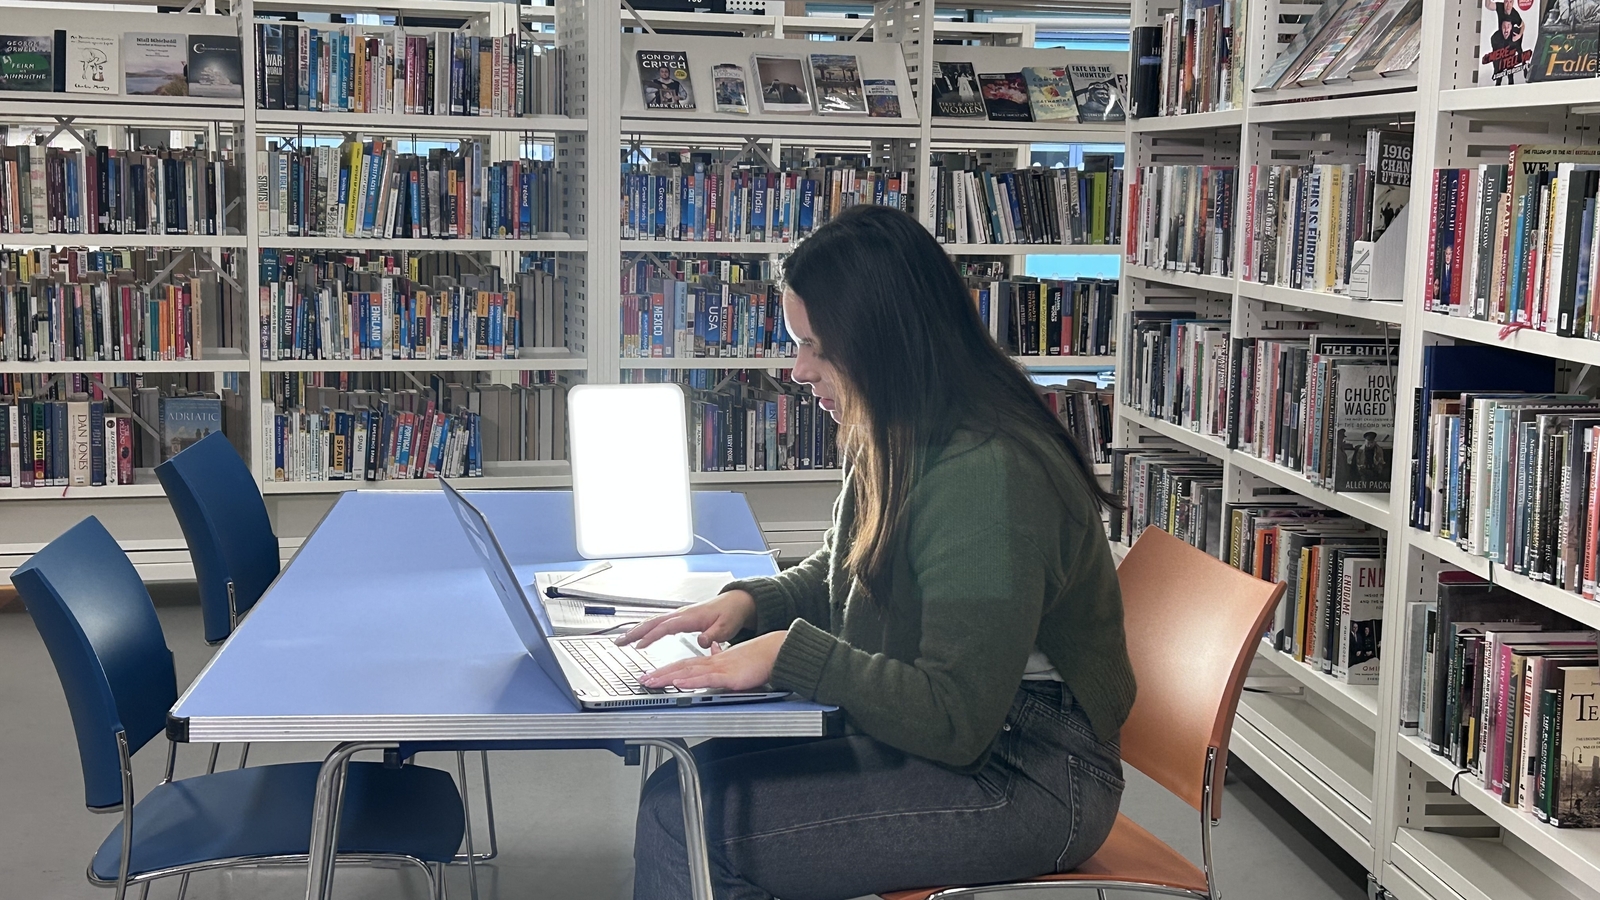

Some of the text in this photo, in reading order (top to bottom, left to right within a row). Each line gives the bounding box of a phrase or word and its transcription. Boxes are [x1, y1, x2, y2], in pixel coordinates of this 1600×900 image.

[266, 54, 282, 66] WAR
[266, 67, 282, 76] WORLD
[642, 61, 686, 69] CRITCH
[940, 106, 983, 114] WOMEN
[1382, 144, 1411, 160] 1916
[1381, 160, 1411, 174] CHAN
[1381, 171, 1410, 186] UTTE
[258, 176, 268, 202] STRAITS
[1267, 170, 1275, 201] AGAINST
[1503, 150, 1516, 238] WE DECLARE
[754, 190, 764, 214] India
[803, 191, 812, 208] Italy
[1439, 174, 1448, 230] MEGHAN
[1448, 180, 1459, 232] Charles III
[1482, 176, 1496, 249] John Bercow
[1264, 218, 1272, 236] ODDS
[1304, 176, 1321, 280] THIS IS EUROPE
[1428, 172, 1440, 286] FINDING FREEDOM
[1522, 186, 1533, 274] BACKWARD GLANCE
[284, 308, 292, 336] IRELAND
[372, 306, 380, 340] ENGLAND
[654, 306, 663, 336] MEXICO
[708, 306, 718, 330] USA
[1324, 346, 1352, 356] THE
[1368, 375, 1396, 388] HOW
[168, 412, 220, 422] ADRIATIC
[1344, 402, 1386, 416] WAGED
[1488, 406, 1496, 422] TIM
[76, 414, 88, 470] DAN JONES
[402, 426, 412, 452] PORTUGAL
[433, 426, 442, 448] NORWAY
[1590, 436, 1598, 470] BETWEEN
[1346, 481, 1368, 490] ALLEN
[1564, 466, 1572, 518] ENDURING
[1232, 516, 1244, 568] Elizabeth
[1327, 572, 1334, 586] OF
[1336, 560, 1345, 614] JOHNSON AT
[1342, 574, 1352, 616] ENDGAME
[1500, 654, 1508, 682] MARY
[1506, 684, 1517, 744] REDMOND
[1524, 690, 1532, 718] TREATY
[1570, 693, 1600, 722] TE
